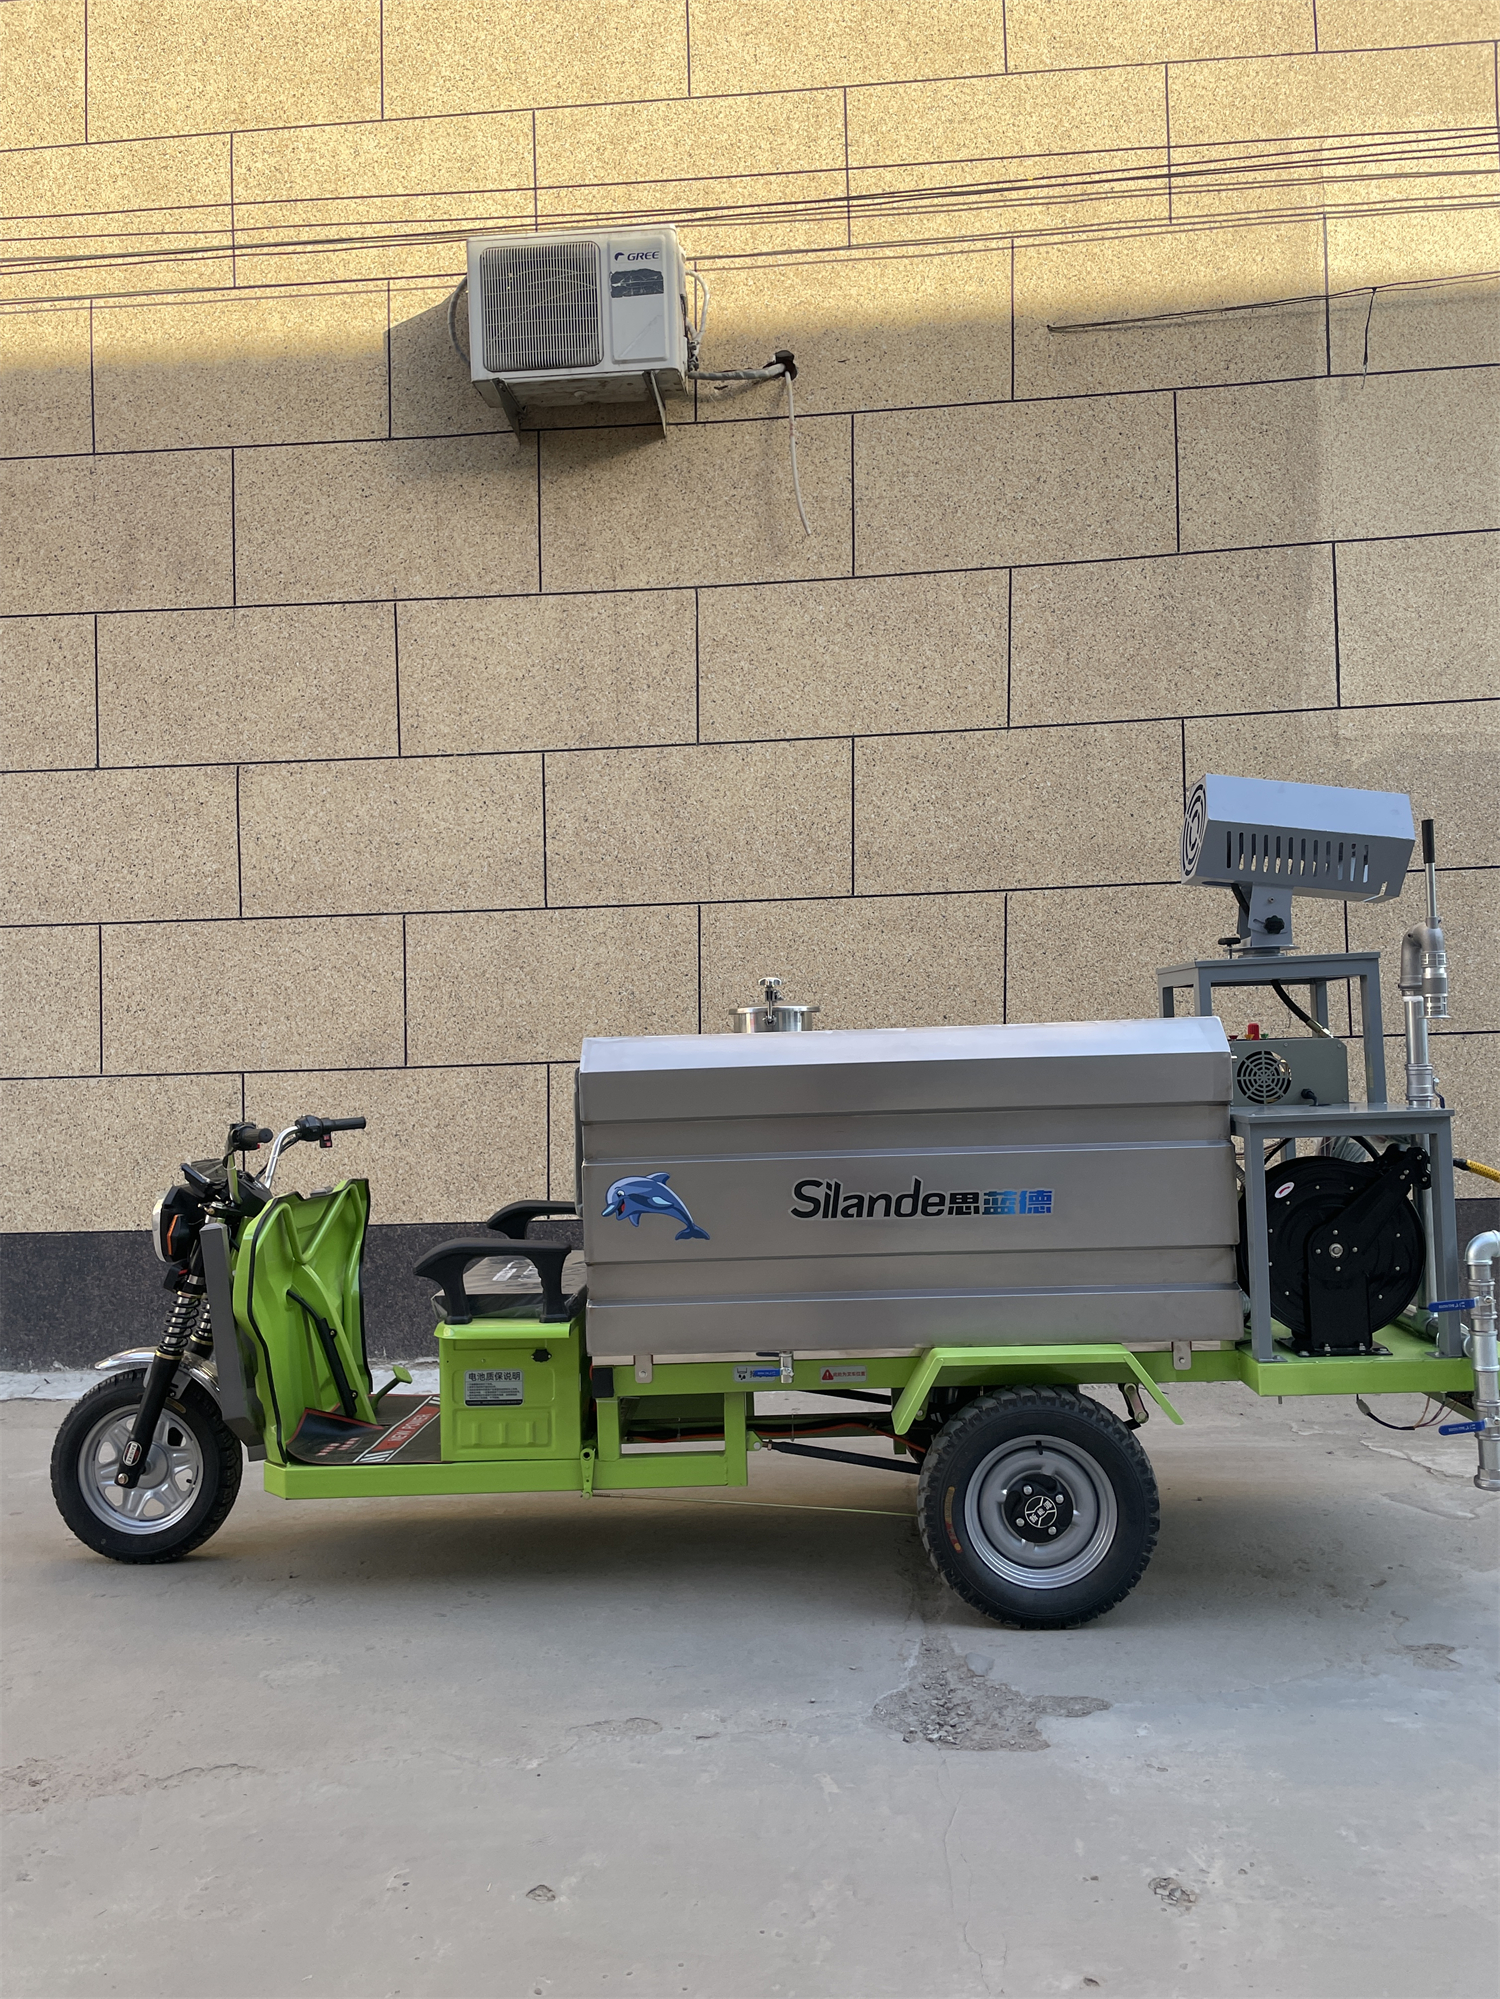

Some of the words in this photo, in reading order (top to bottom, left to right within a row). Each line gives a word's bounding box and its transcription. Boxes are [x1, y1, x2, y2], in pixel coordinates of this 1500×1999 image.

[627, 250, 660, 262] GREE
[790, 1176, 946, 1219] Silande
[948, 1189, 1053, 1216] 思蓝德
[468, 1371, 521, 1382] 电池质保说明
